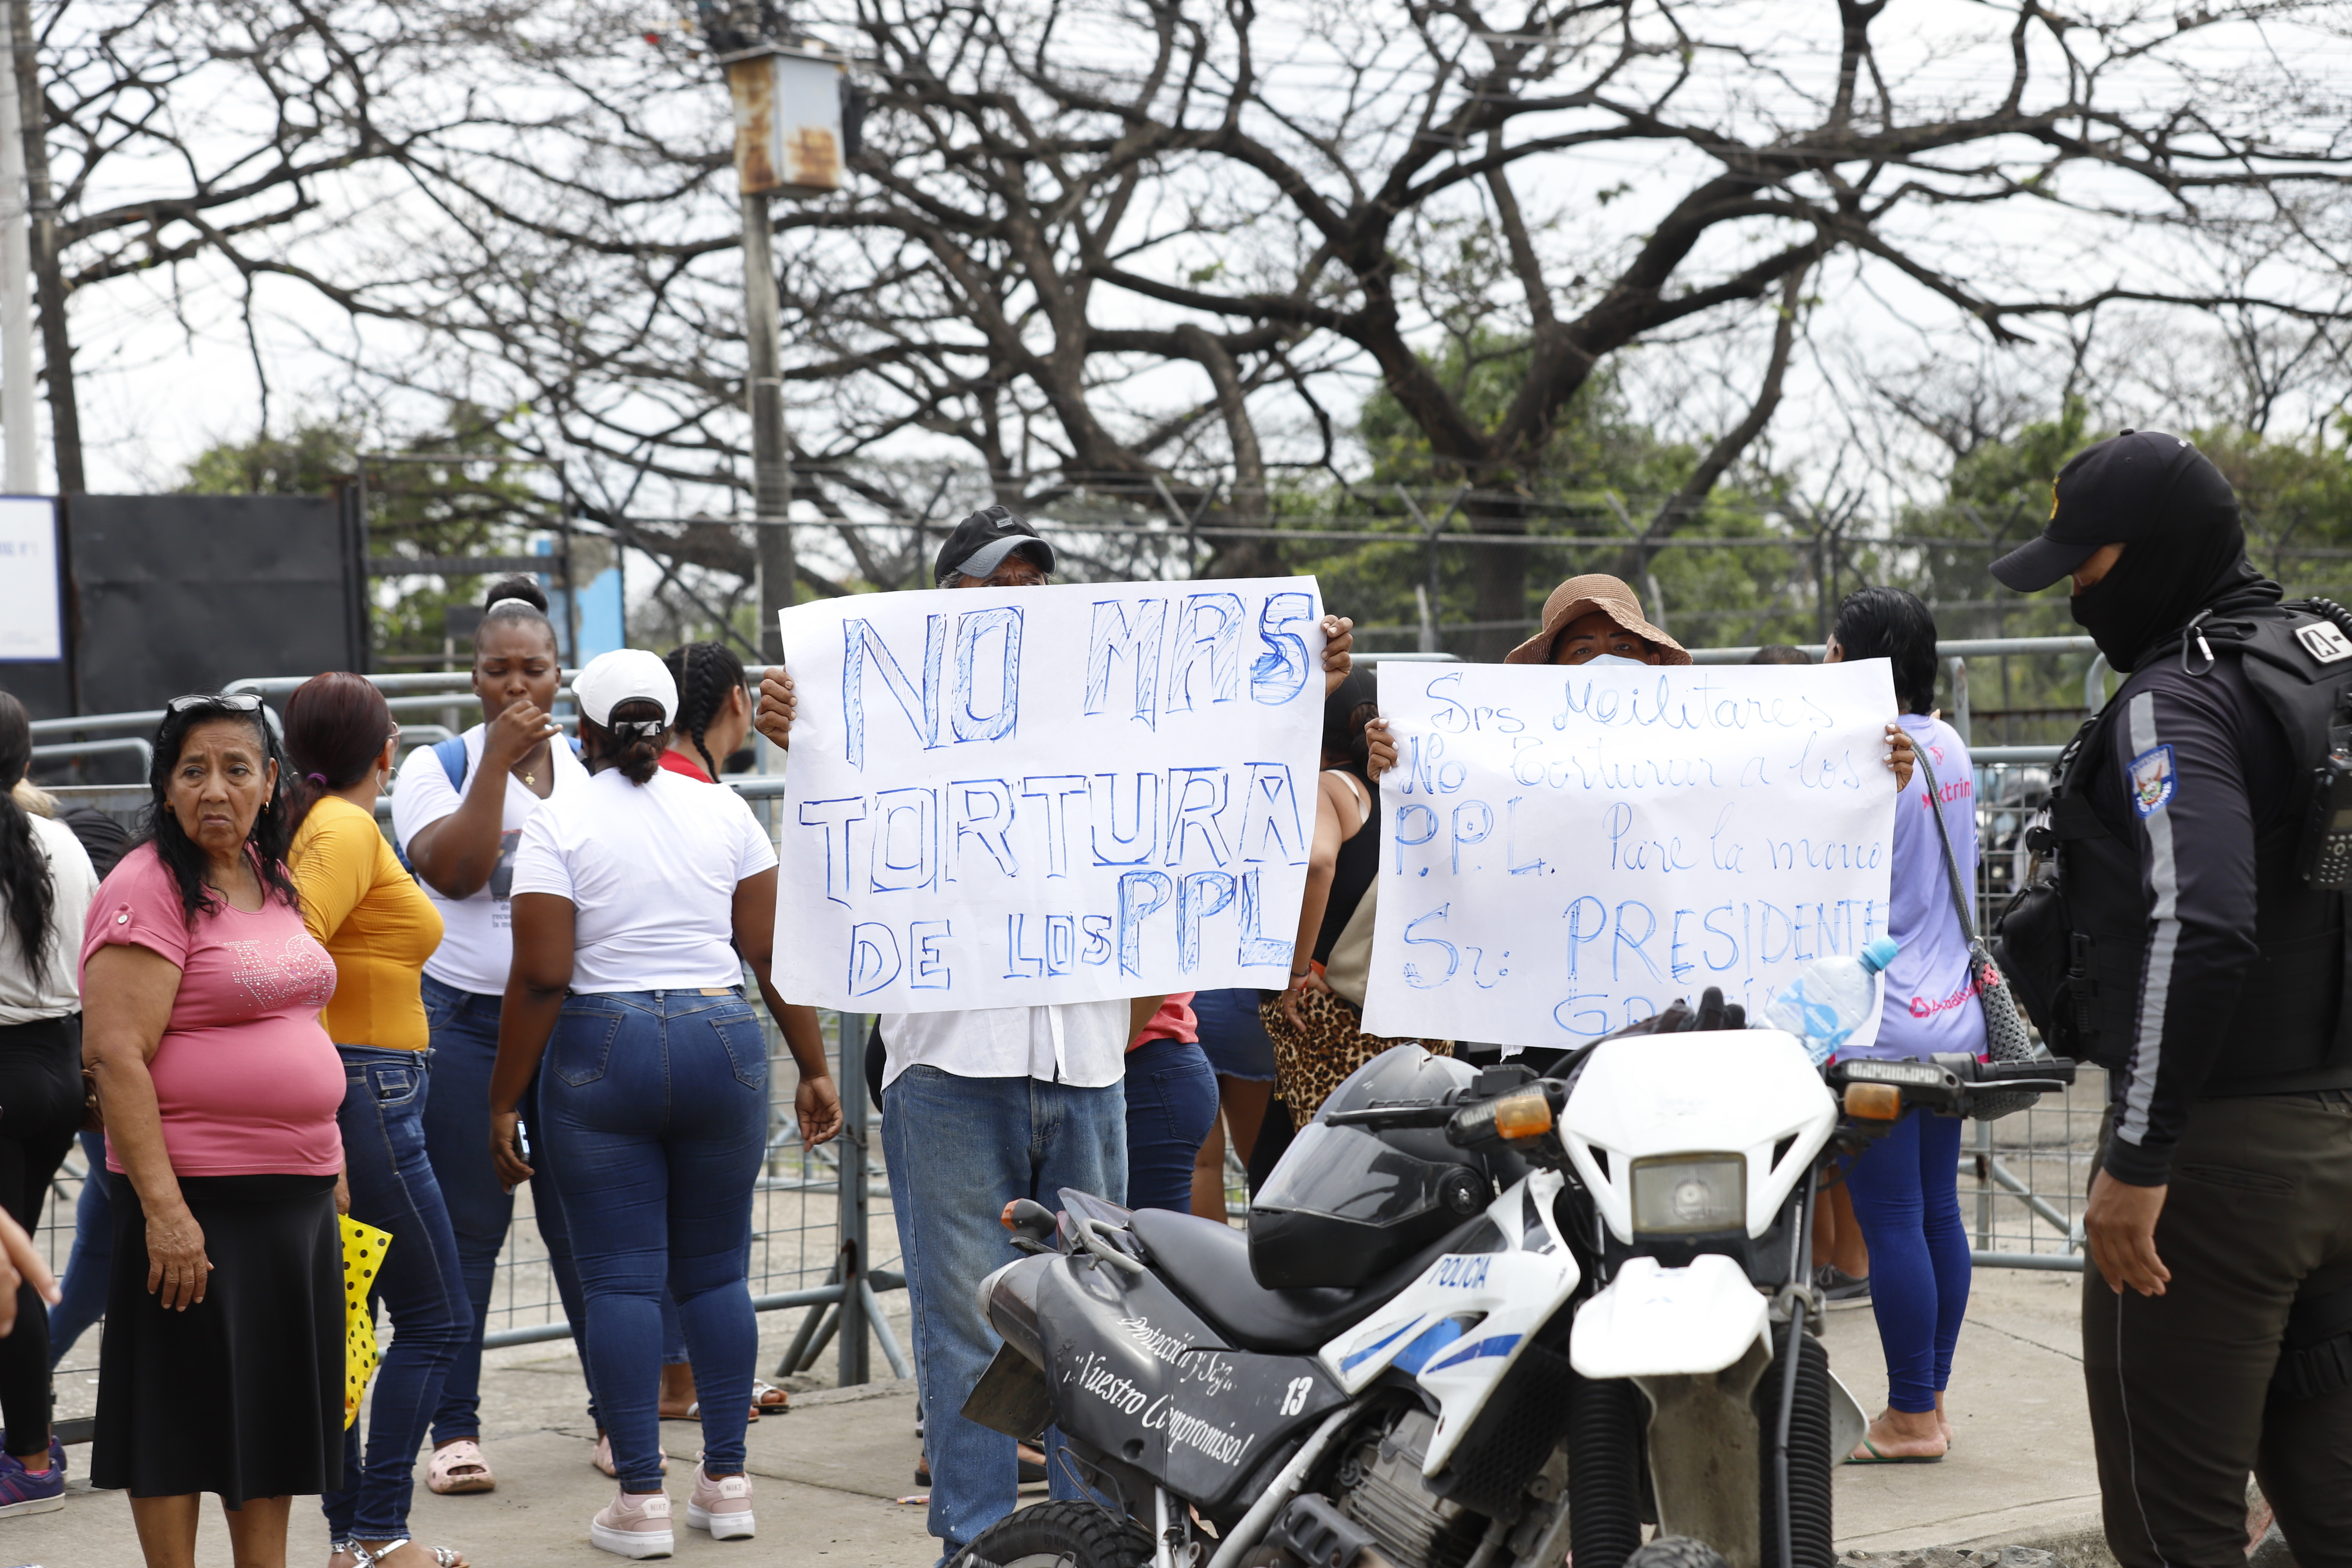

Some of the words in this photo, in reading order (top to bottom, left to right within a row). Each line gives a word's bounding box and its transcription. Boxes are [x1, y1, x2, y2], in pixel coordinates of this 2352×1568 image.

[842, 606, 1023, 772] NO
[1426, 672, 1525, 733] Srs
[1399, 733, 1467, 795] No
[1740, 756, 1772, 787] a
[1788, 731, 1860, 790] los
[799, 763, 1308, 910] TORTURA
[1710, 802, 1747, 873] la
[849, 919, 955, 997] DE
[1003, 911, 1112, 978] LOS
[1116, 866, 1294, 979] PPL
[1563, 895, 1889, 985] PRESIDENTE
[1427, 1255, 1493, 1289] POLICIA
[1280, 1376, 1314, 1416] 13
[650, 1503, 667, 1511] NIKE
[726, 1483, 743, 1492] NIKE
